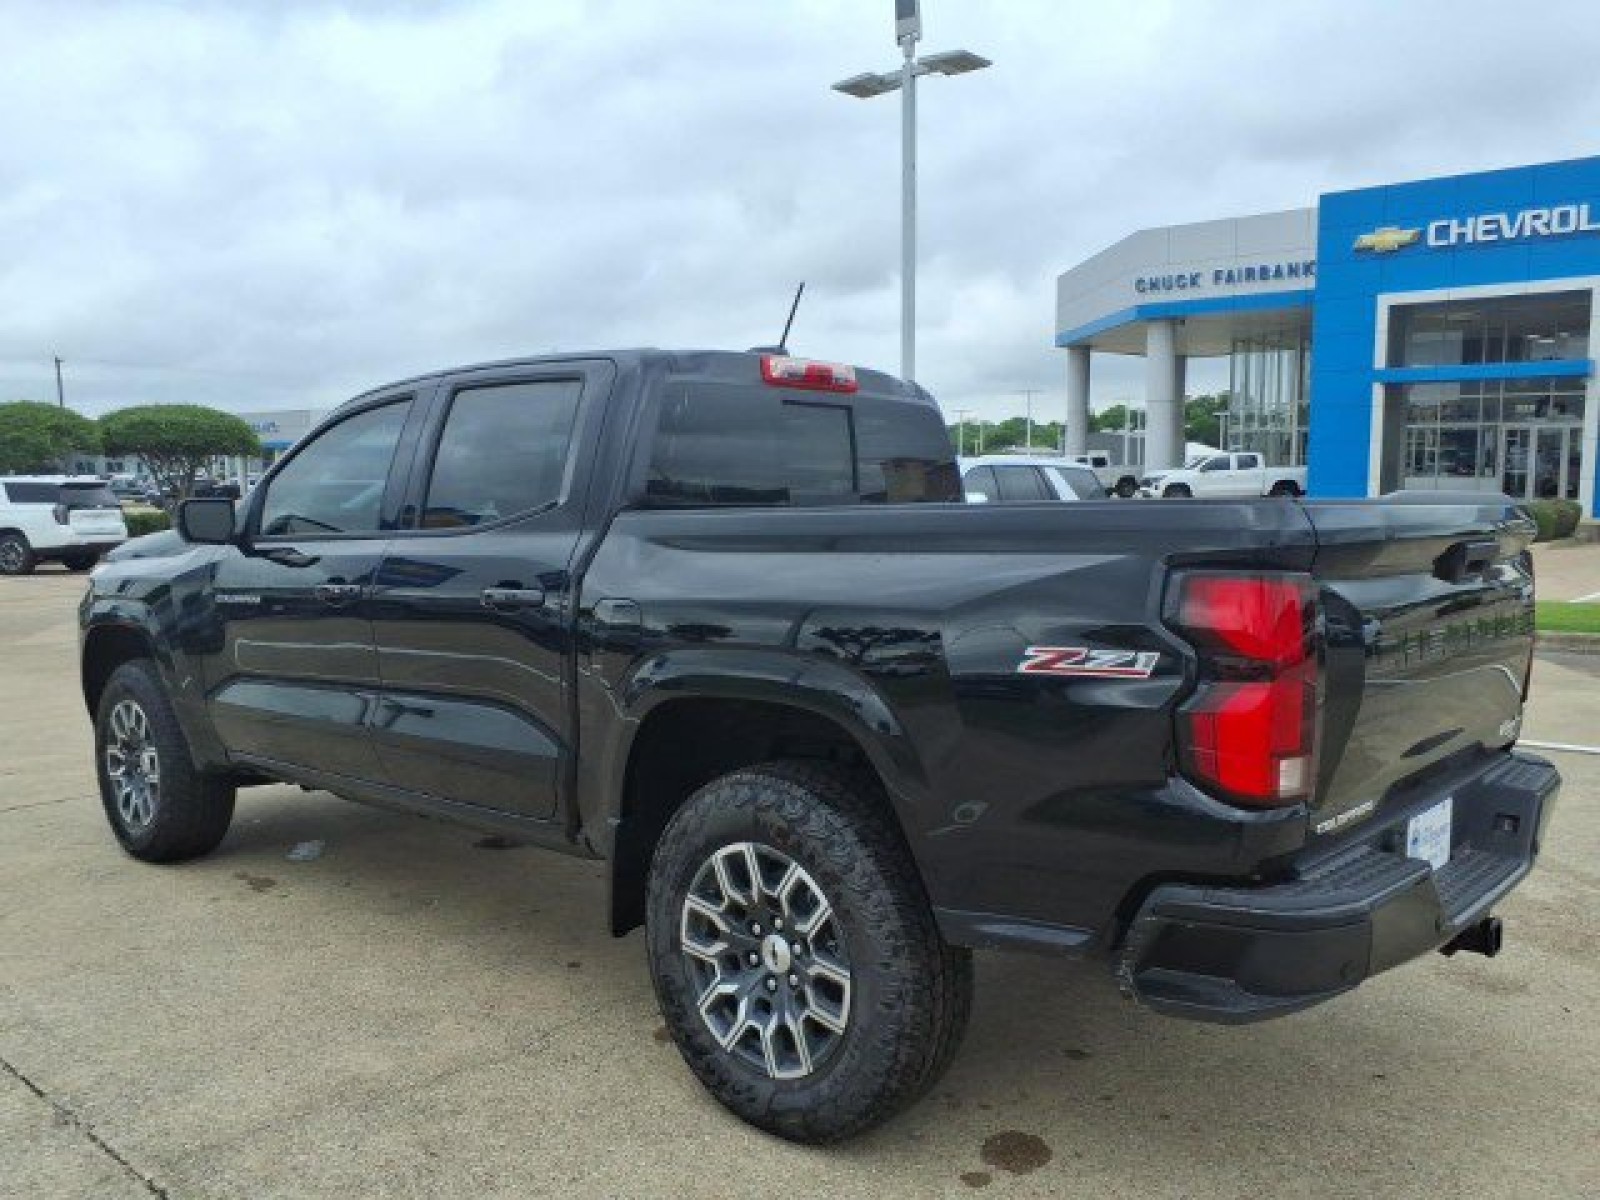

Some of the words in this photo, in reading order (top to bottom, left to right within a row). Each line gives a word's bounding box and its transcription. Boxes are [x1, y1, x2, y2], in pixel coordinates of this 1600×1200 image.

[1427, 204, 1600, 246] CHEVROL
[1134, 272, 1202, 293] CHUCK
[1214, 260, 1316, 286] FAIRBANK
[1017, 647, 1160, 678] Z71
